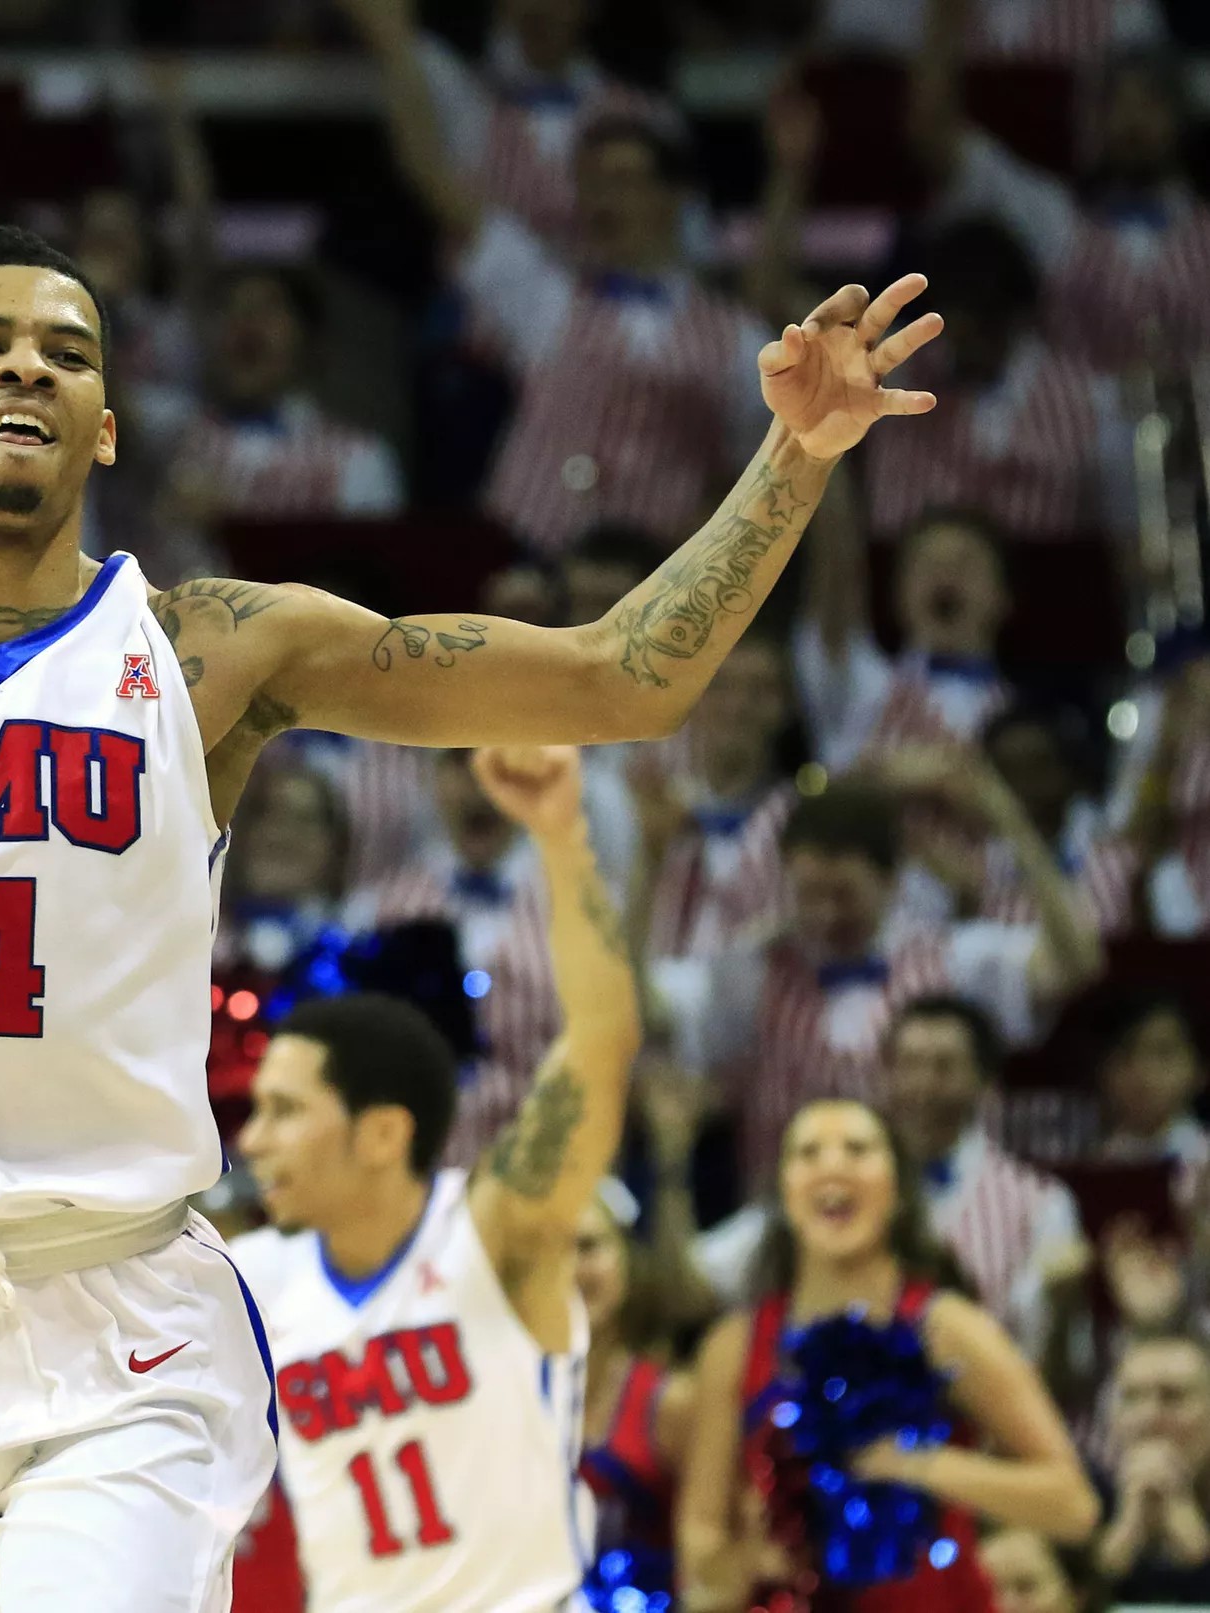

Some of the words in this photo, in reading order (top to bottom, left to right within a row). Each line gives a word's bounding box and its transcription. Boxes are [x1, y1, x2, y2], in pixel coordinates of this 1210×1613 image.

[115, 653, 160, 699] A
[276, 1321, 472, 1443] SMU
[348, 1439, 456, 1559] 11
